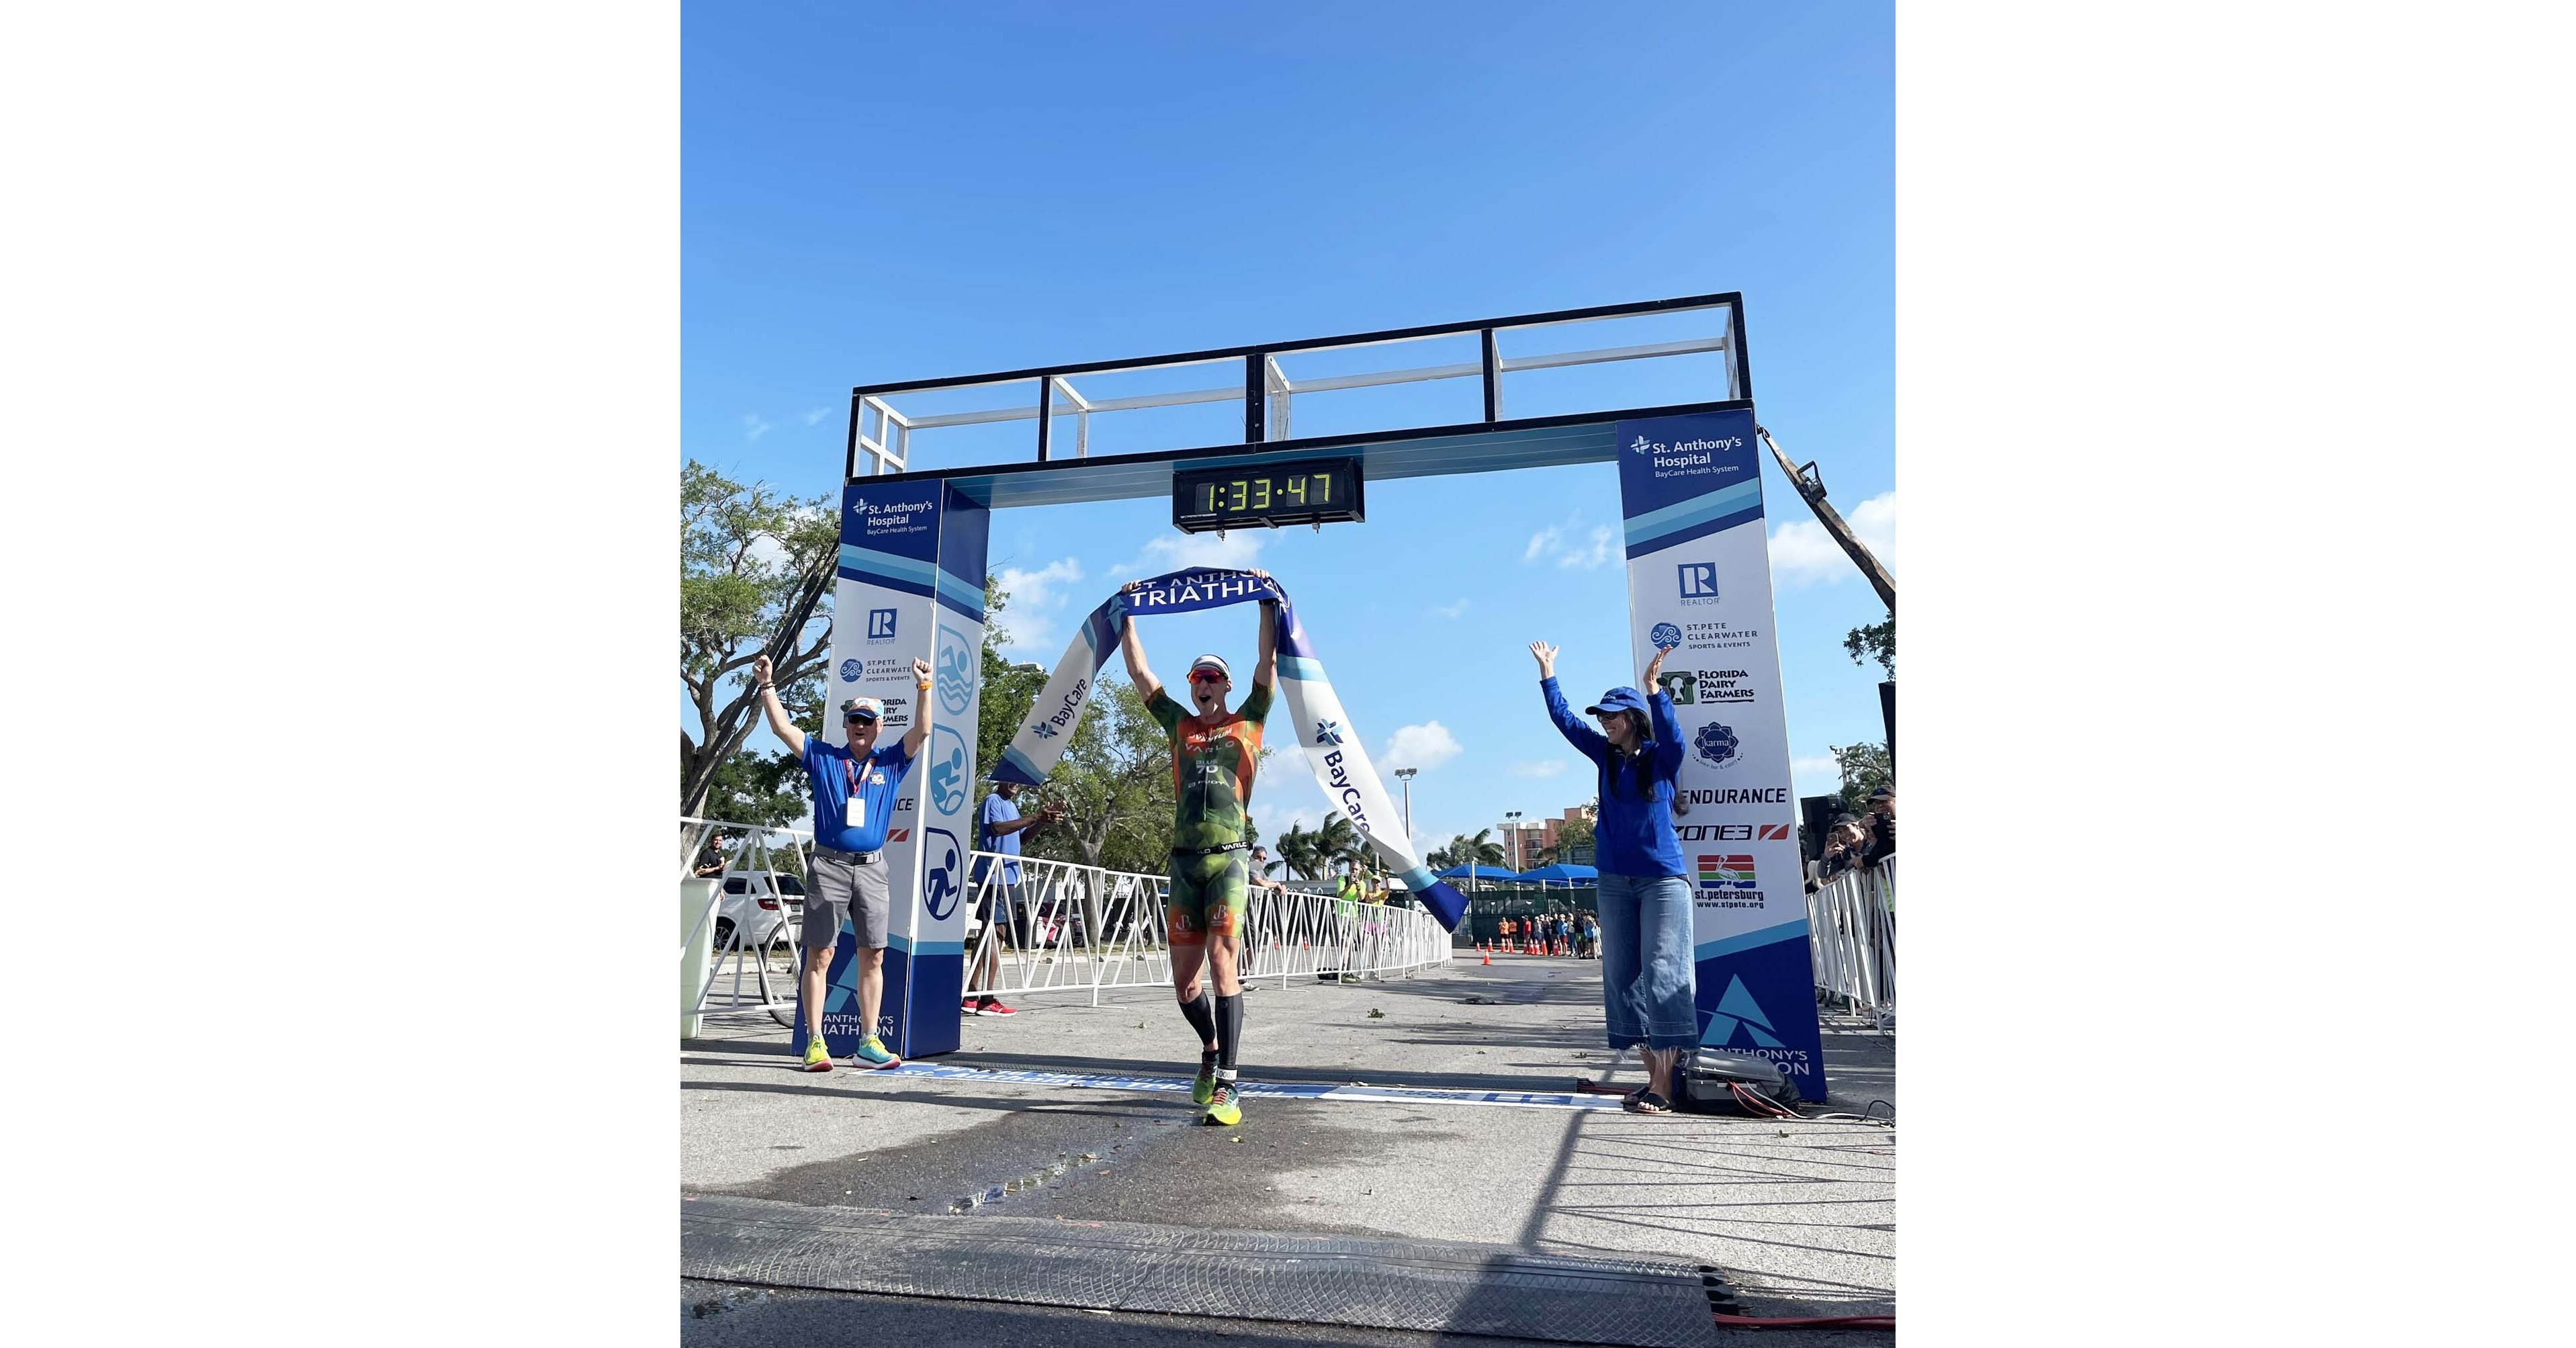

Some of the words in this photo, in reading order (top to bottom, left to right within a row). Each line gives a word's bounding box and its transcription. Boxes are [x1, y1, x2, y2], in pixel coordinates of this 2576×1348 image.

[1653, 443, 1670, 454] St.
[1674, 437, 1742, 452] Anthony's
[1654, 452, 1710, 468] Hospital
[1655, 469, 1685, 478] BayCare
[1687, 467, 1711, 476] Health
[1712, 465, 1739, 474] System
[868, 505, 881, 515] St.
[883, 500, 932, 514] Anthony's
[868, 514, 909, 527] Hospital
[867, 528, 889, 536] BayCare
[1681, 597, 1720, 606] REALTOR
[1687, 630, 1758, 640] CLEARWATER
[867, 666, 911, 674] CLEARWATE
[1698, 670, 1748, 679] FLORIDA
[1699, 680, 1736, 688] DAIRY
[1700, 689, 1755, 699] FARMERS
[1050, 678, 1087, 727] BayCare
[883, 715, 908, 723] MERS
[1703, 738, 1729, 747] karma
[1695, 889, 1764, 901] st.petersburg
